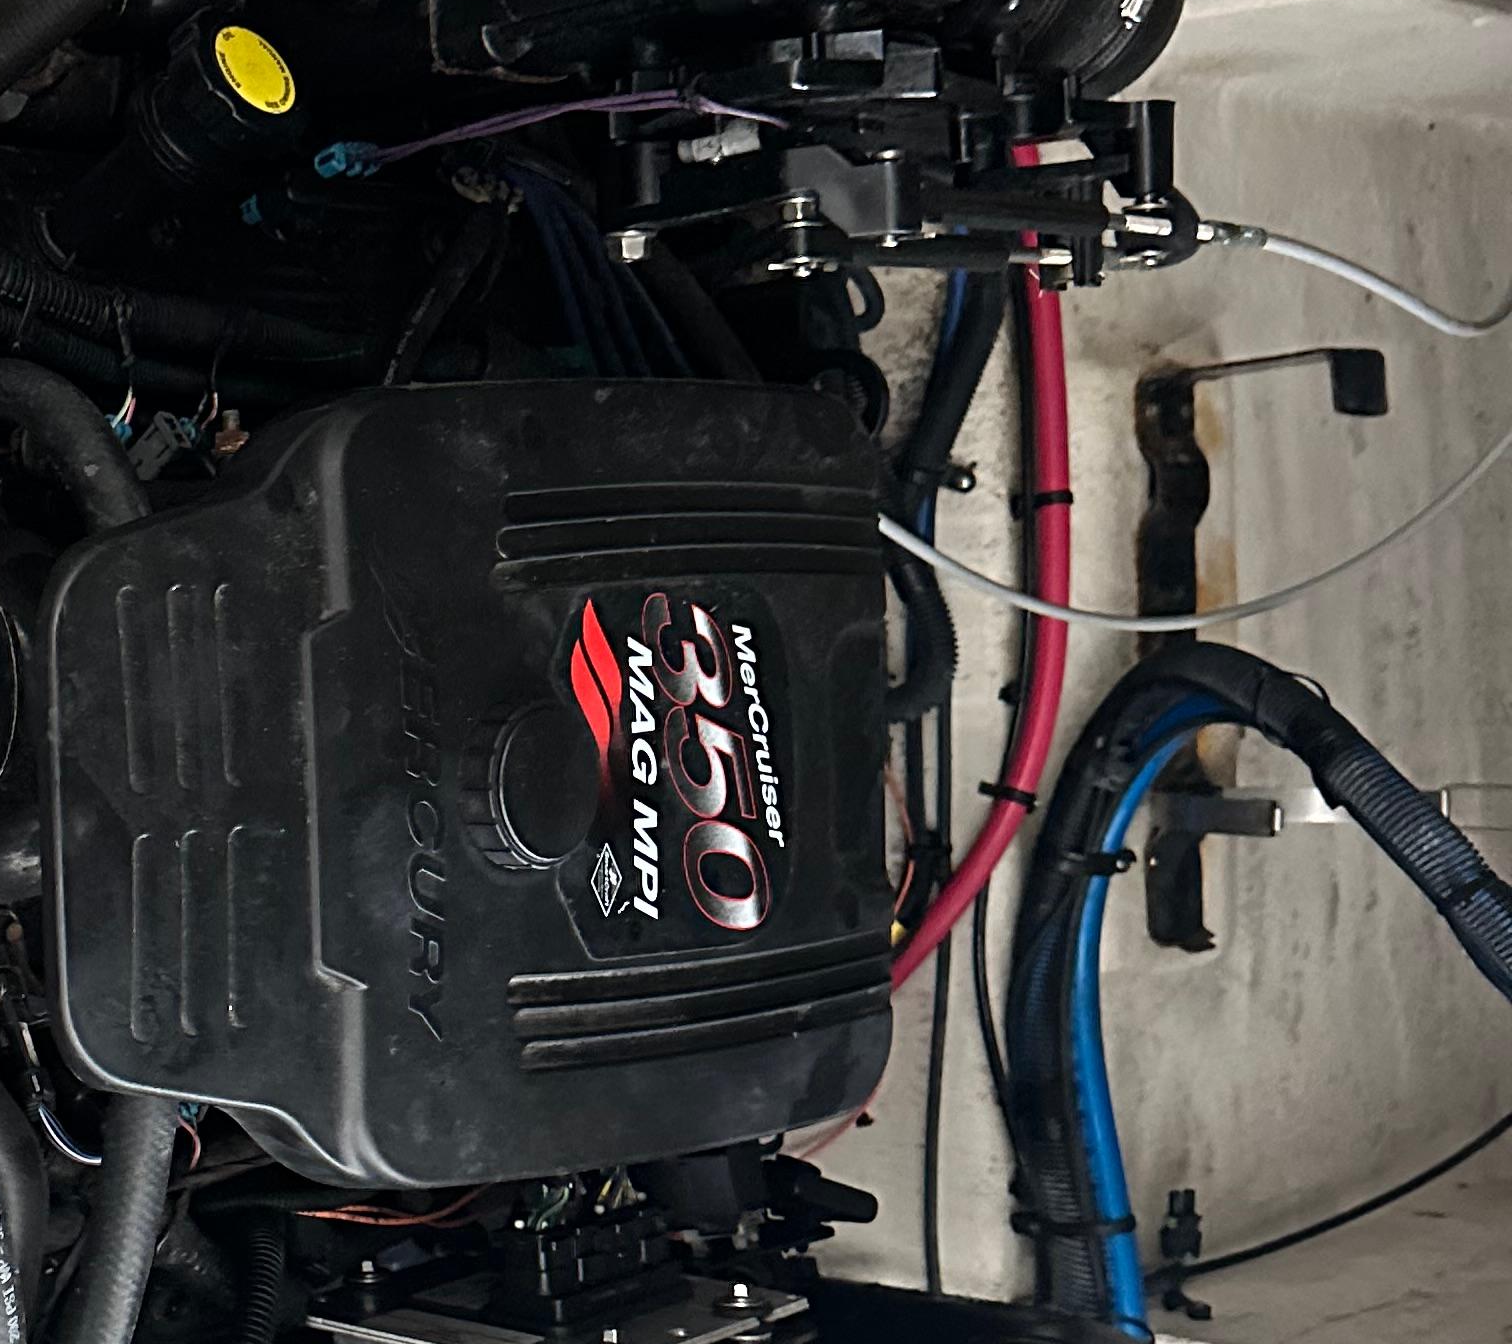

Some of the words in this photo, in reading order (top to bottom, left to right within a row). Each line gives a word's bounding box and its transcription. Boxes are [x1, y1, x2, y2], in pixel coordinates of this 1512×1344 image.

[627, 636, 659, 786] MAG
[641, 592, 773, 931] 350
[731, 624, 785, 848] MerCruiser
[633, 799, 659, 921] MPI
[2, 1285, 17, 1315] PSI
